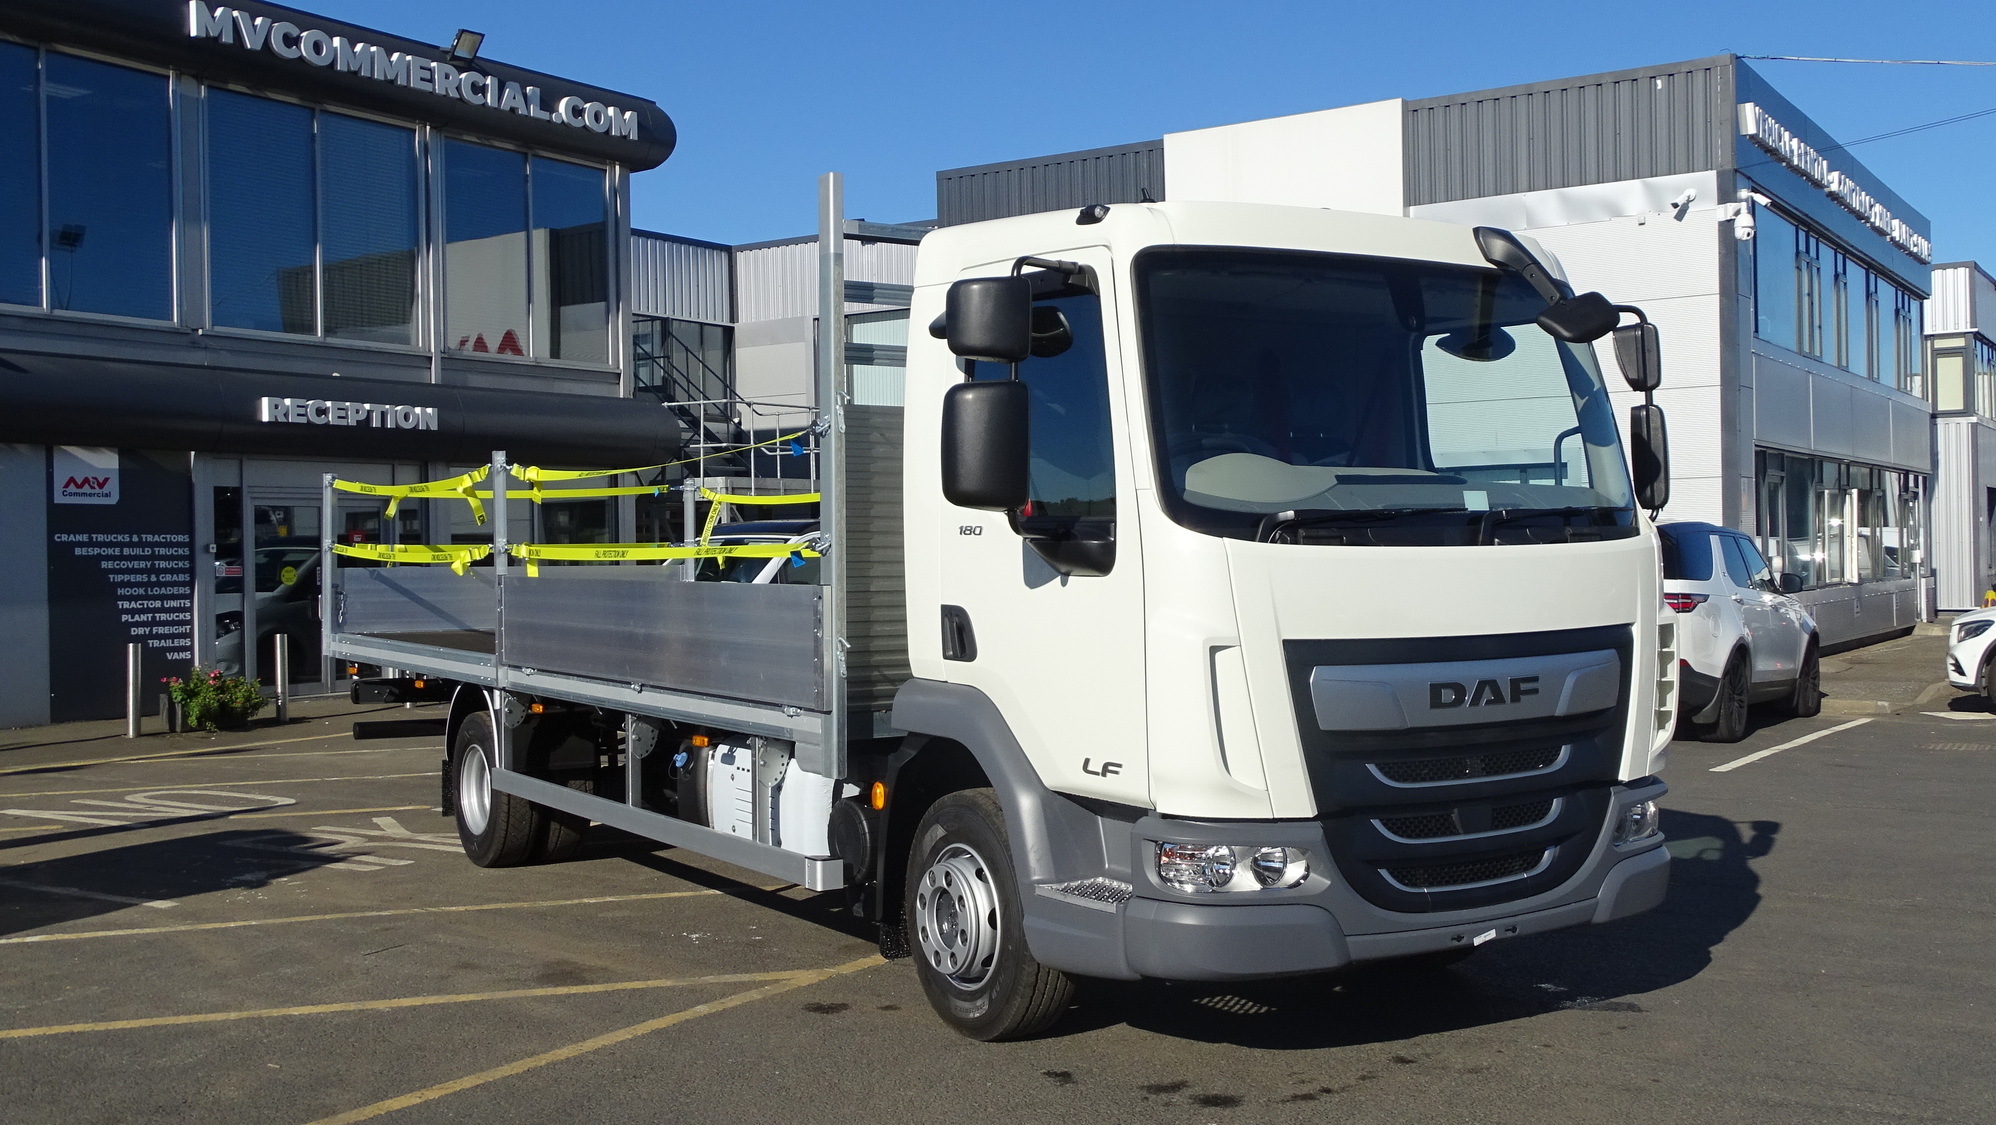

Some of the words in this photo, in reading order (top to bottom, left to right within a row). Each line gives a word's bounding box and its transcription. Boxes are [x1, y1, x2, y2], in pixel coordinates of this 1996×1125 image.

[188, 0, 639, 141] MVCOMMERCIAL.COM
[261, 396, 439, 431] RECEPTION
[62, 489, 112, 498] Commercial
[958, 525, 983, 536] 180
[54, 533, 89, 542] CRANE
[91, 533, 130, 542] TRUCKS
[132, 534, 139, 542] &
[141, 534, 190, 542] TRACTORS
[74, 547, 121, 556] BESPOKE
[123, 547, 151, 556] BUILD
[154, 547, 190, 555] TRUCKS
[101, 561, 151, 569] RECOVERY
[154, 560, 190, 568] TRUCKS
[108, 574, 148, 582] TIPPERS
[150, 574, 157, 582] &
[159, 573, 190, 582] GRABS
[117, 587, 146, 595] HOOK
[148, 586, 191, 595] LOADERS
[117, 601, 162, 609] TRACTOR
[163, 599, 191, 608] UNITS
[121, 614, 153, 622] PLANT
[154, 612, 191, 621] TRUCKS
[130, 627, 151, 635] DRY
[152, 625, 192, 634] FREIGHT
[147, 638, 191, 648] TRAILERS
[166, 651, 191, 660] VANS
[1428, 676, 1540, 710] DAF
[1082, 757, 1123, 778] LF
